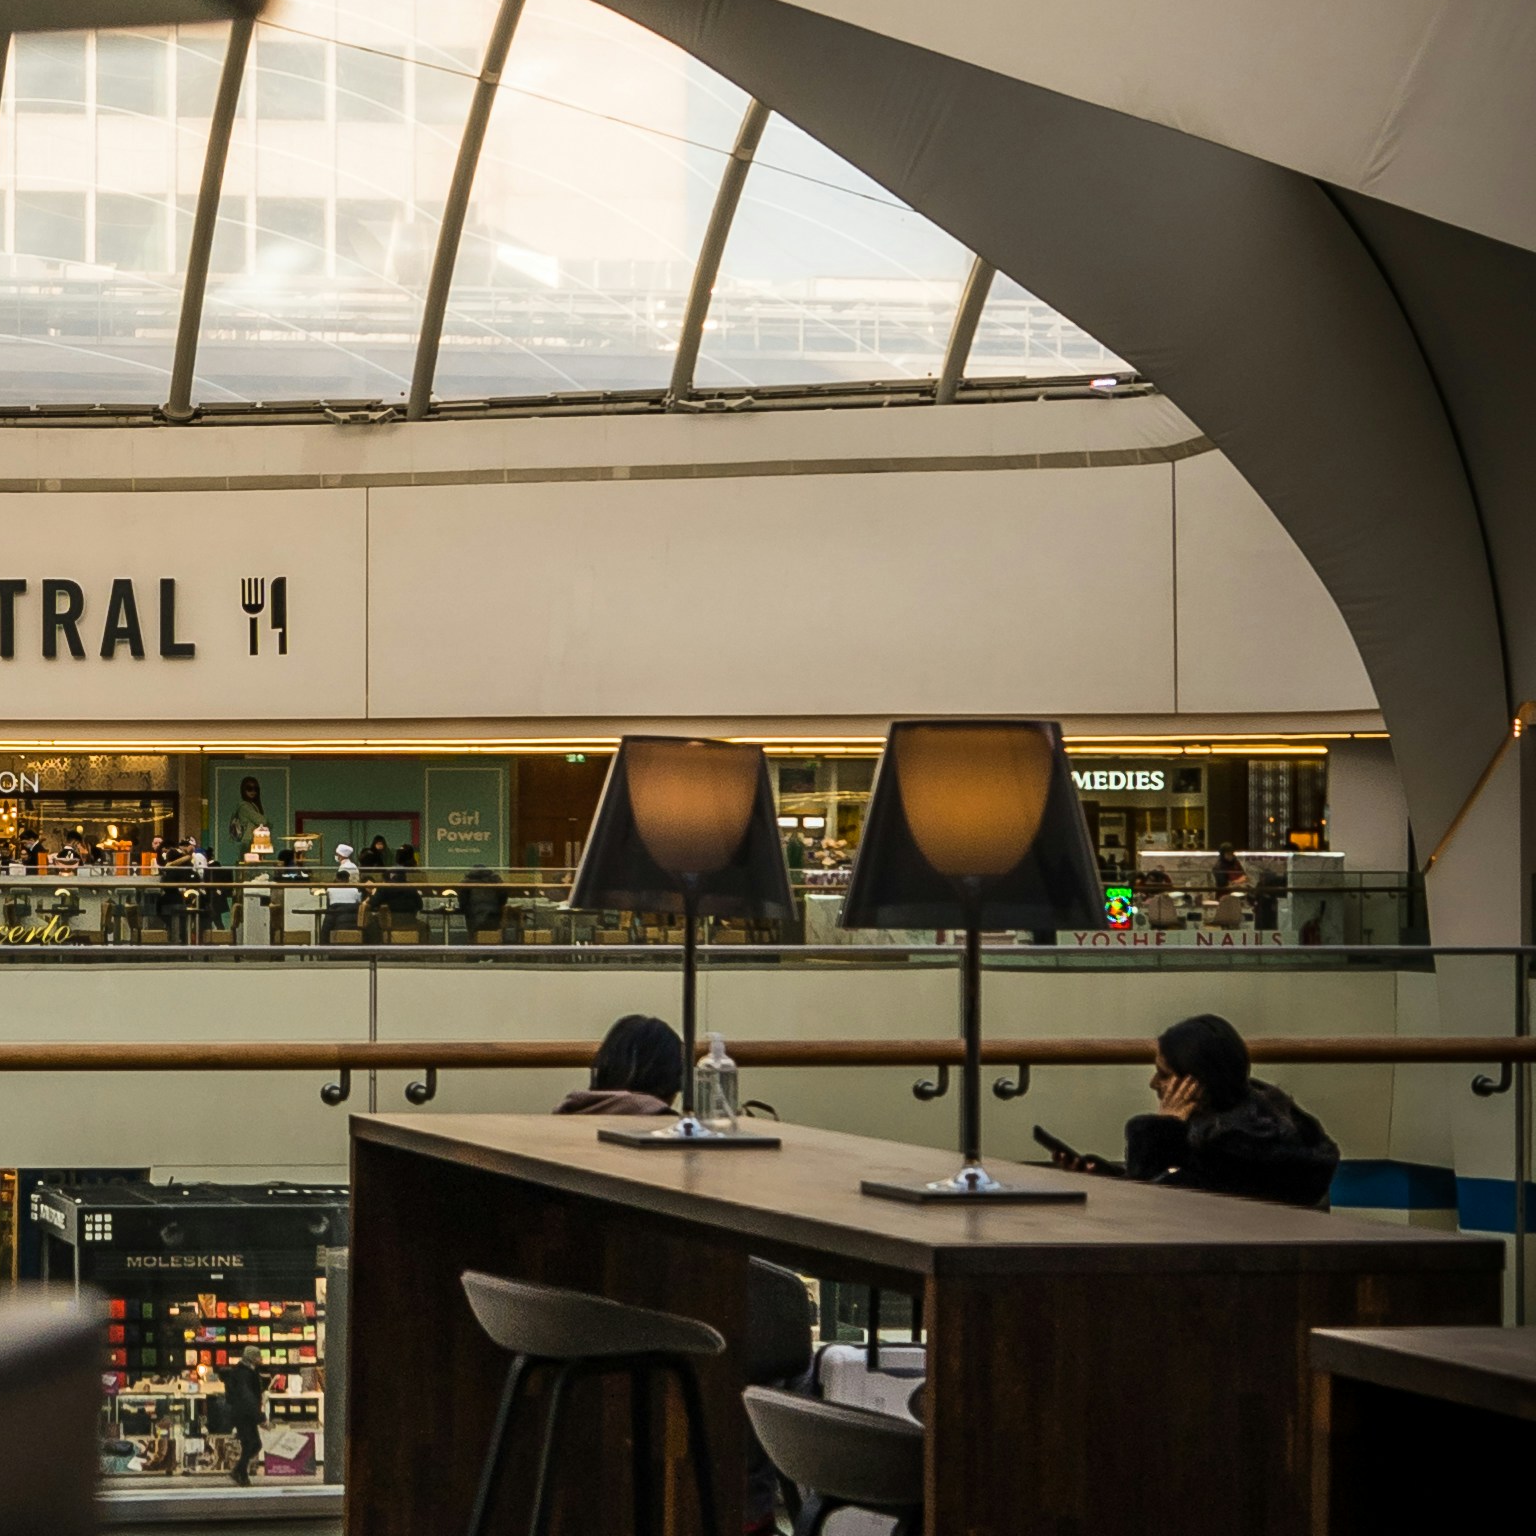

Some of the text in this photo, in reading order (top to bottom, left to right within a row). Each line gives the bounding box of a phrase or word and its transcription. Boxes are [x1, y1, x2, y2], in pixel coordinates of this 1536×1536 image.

[448, 810, 480, 825] Girl
[436, 828, 491, 841] Power
[127, 1254, 244, 1268] MOLESKINE
